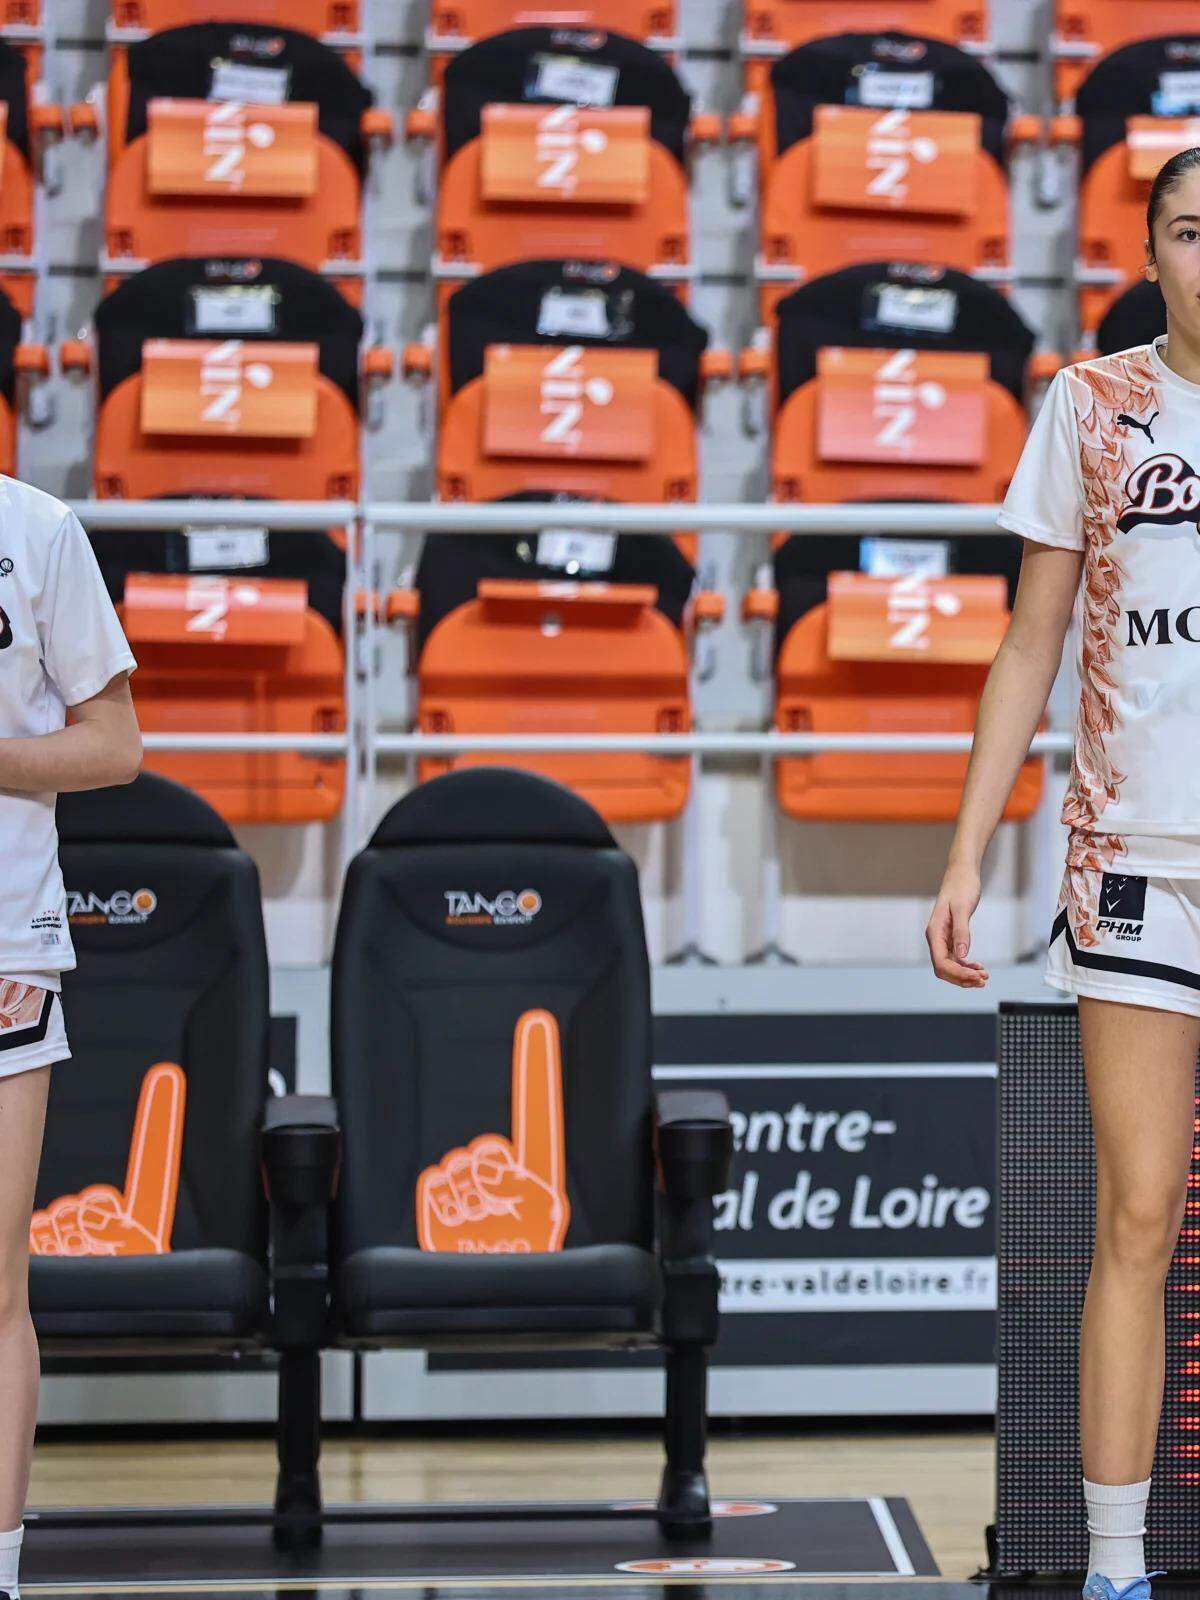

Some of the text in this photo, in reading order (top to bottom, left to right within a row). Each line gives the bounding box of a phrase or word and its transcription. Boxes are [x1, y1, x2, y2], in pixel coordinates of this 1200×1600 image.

[444, 889, 542, 917] TANGO
[1095, 920, 1144, 936] PHM
[1115, 934, 1142, 942] GROUP
[728, 1102, 897, 1152] entre-
[712, 1169, 991, 1231] al de Loire
[719, 1266, 990, 1297] tre-valdeloire.fr
